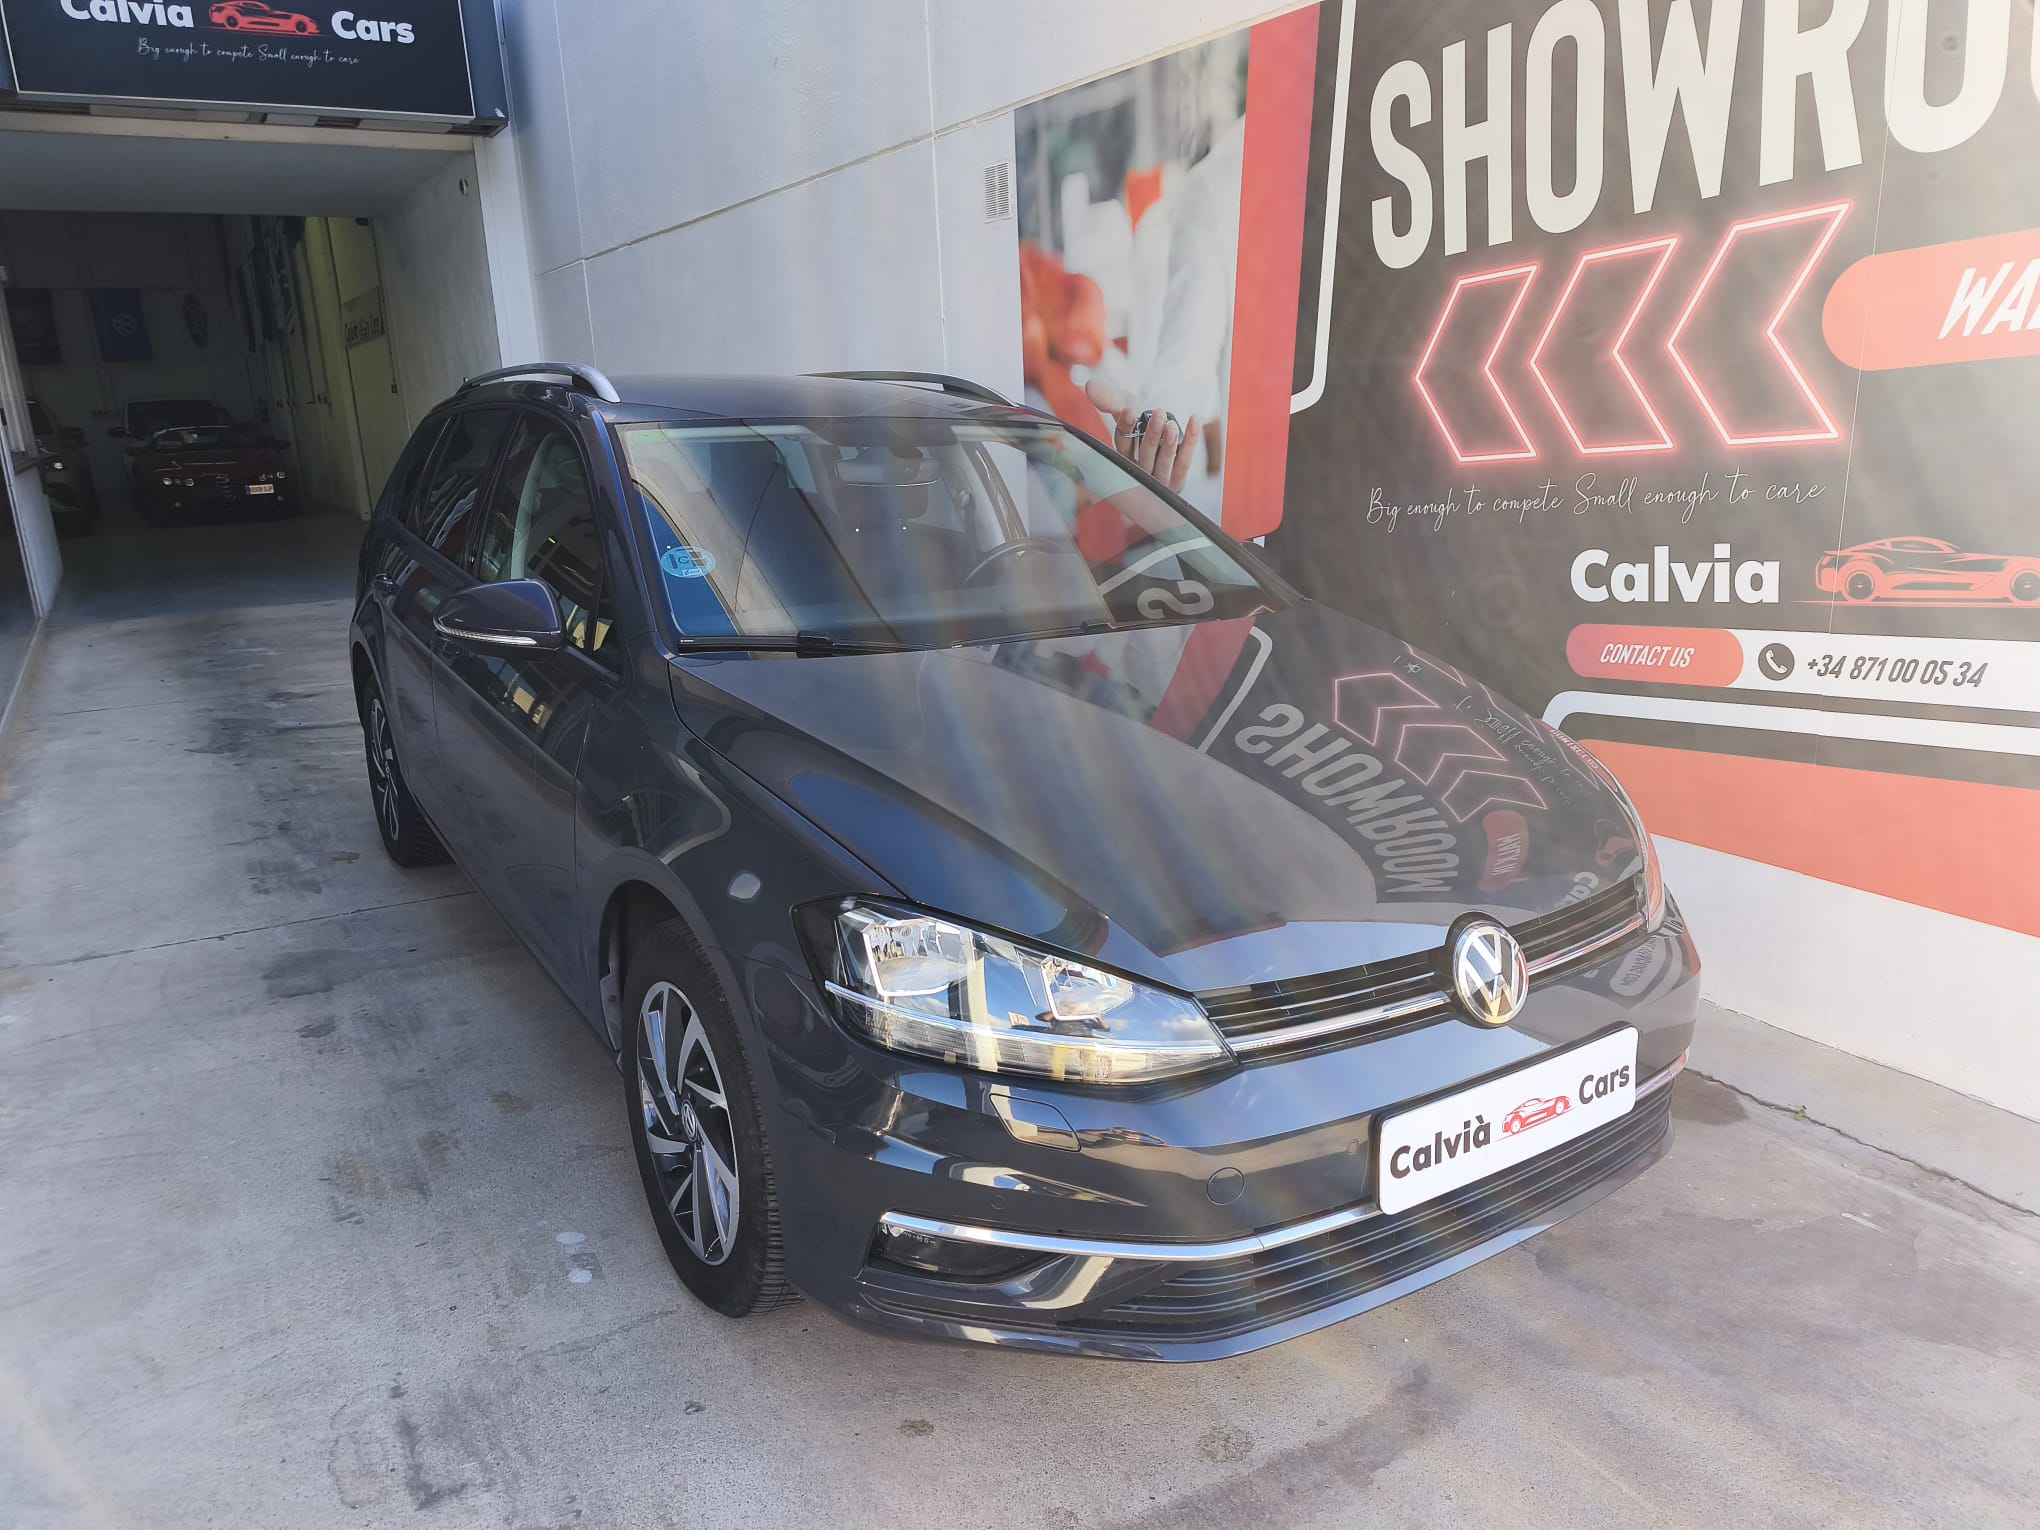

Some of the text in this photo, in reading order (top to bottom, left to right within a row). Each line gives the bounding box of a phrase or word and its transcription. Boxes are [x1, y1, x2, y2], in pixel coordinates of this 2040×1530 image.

[331, 10, 415, 44] Cars
[138, 37, 360, 68] Big enough to compete Small enough to care
[1366, 465, 1825, 533] Big enough to compete Small enough to care
[1570, 543, 1780, 604] Calvia
[1600, 643, 1695, 668] CONTACT US
[1807, 653, 1847, 679] +34
[1919, 660, 1953, 685] 05
[1952, 661, 1989, 687] 34
[1389, 1065, 1630, 1179] Calvià Cars
